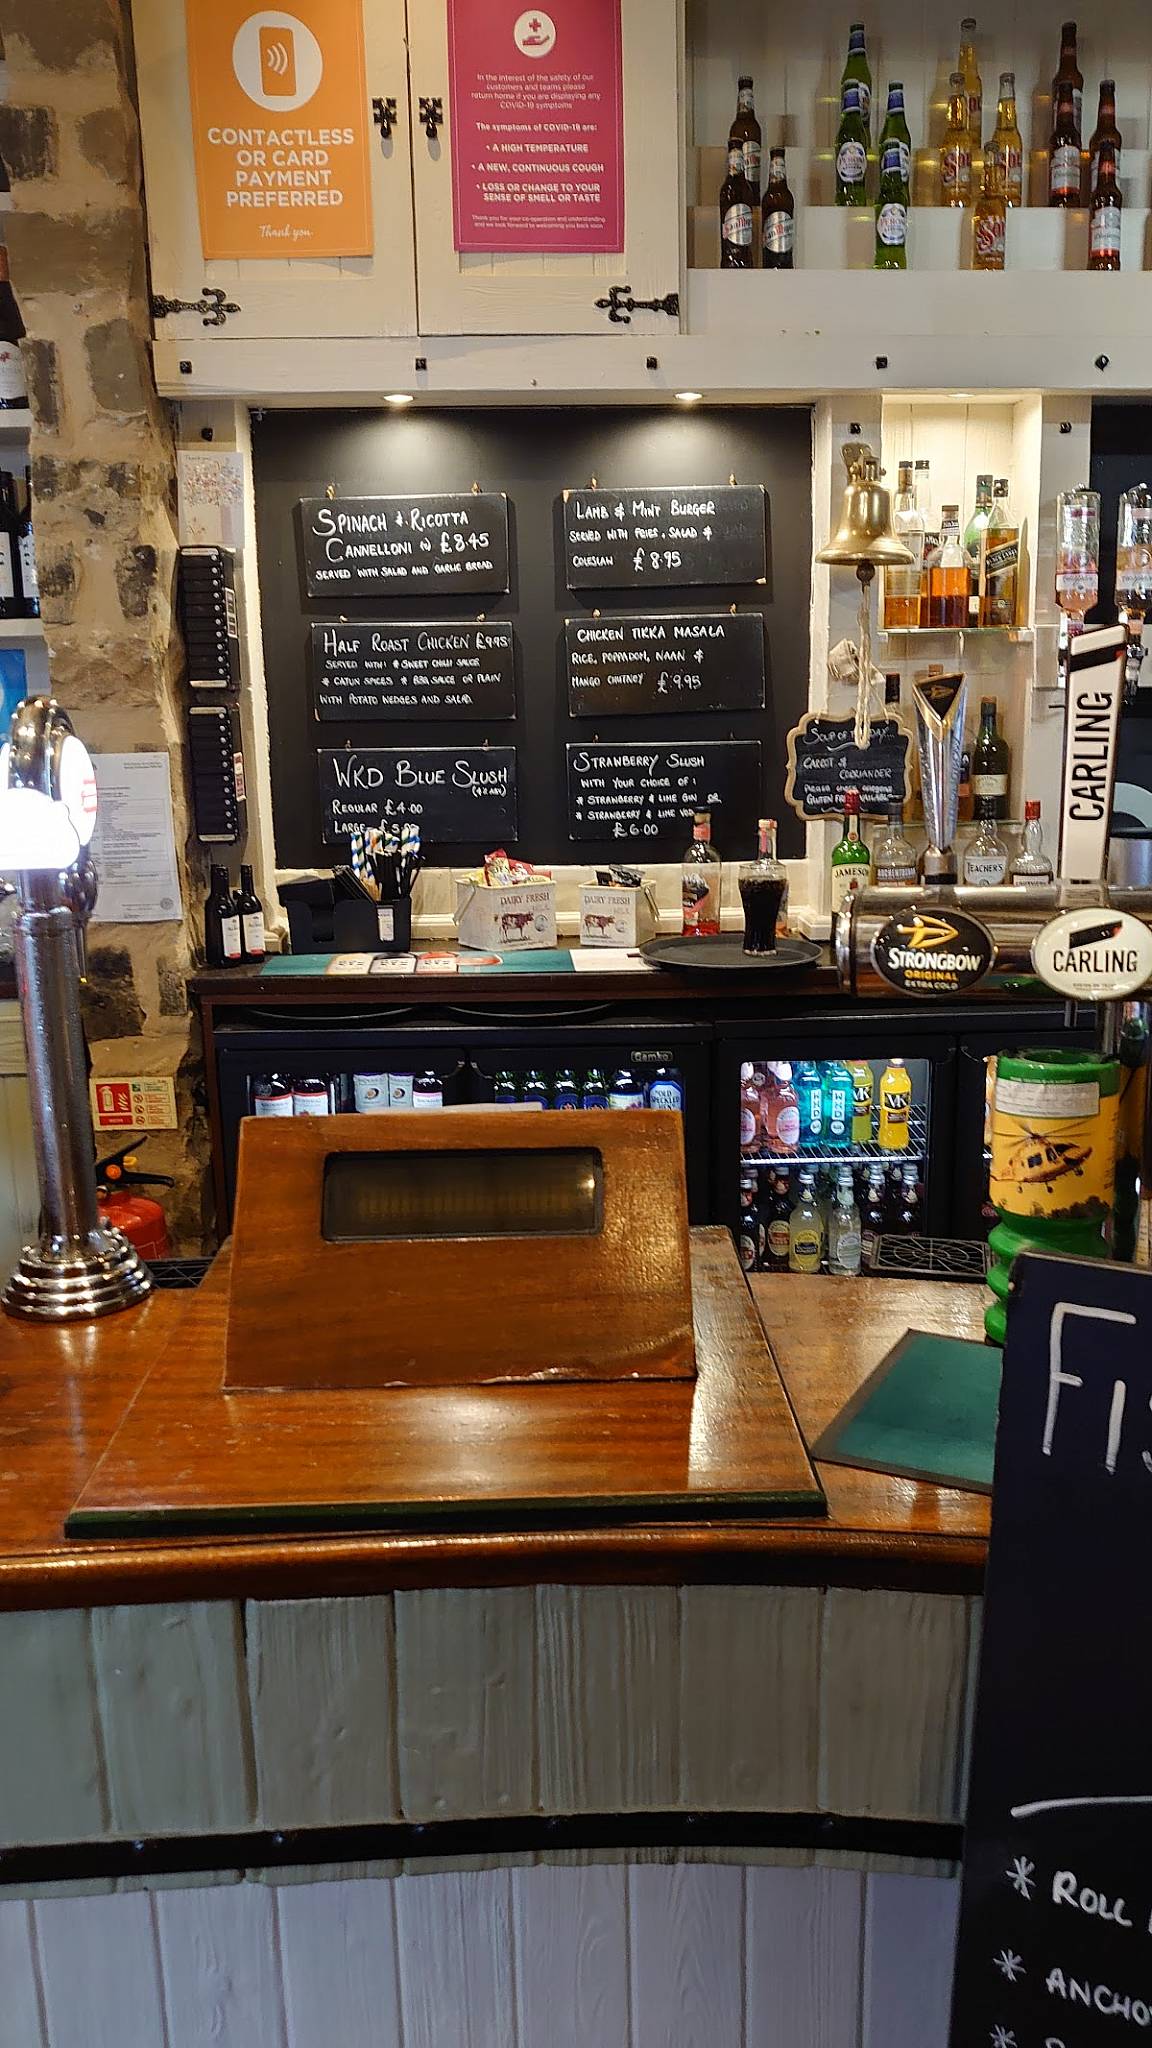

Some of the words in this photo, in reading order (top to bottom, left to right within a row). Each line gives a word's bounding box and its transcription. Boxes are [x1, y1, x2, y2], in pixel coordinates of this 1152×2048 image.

[492, 124, 531, 132] symptoms
[534, 123, 542, 131] of
[208, 128, 354, 145] CONTACTLESS
[492, 144, 499, 152] A
[502, 144, 523, 153] HIGH
[525, 144, 589, 153] TEMPERATURE
[237, 150, 266, 166] OR
[272, 150, 328, 166] CARD
[512, 164, 570, 173] CONTINUOUS
[572, 164, 604, 173] COUGH
[236, 170, 331, 186] PAYMENT
[482, 184, 505, 192] LOSS
[507, 184, 520, 192] OR
[522, 184, 559, 193] CHANGE
[561, 184, 574, 192] TO
[575, 184, 601, 193] YOUR
[227, 191, 343, 208] PREFERRED
[484, 193, 511, 202] SENSE
[513, 193, 525, 202] OF
[528, 193, 556, 202] SMELL
[559, 193, 571, 202] OR
[573, 194, 601, 202] TASTE
[259, 224, 291, 238] Thank
[576, 500, 609, 520] LAMB
[632, 499, 661, 518] MINT
[670, 499, 715, 516] BURGER
[312, 508, 388, 536] SPINACH
[410, 507, 469, 532] RICOTTA
[569, 530, 601, 543] SERVED
[607, 528, 628, 541] WITH
[668, 526, 697, 540] SALAD
[326, 538, 413, 563] CANNELLONI
[440, 532, 490, 554] £8.45
[572, 555, 614, 568] COLESLAW
[316, 569, 351, 581] SERVED
[357, 567, 378, 578] WITH
[381, 566, 408, 577] SALAD
[411, 566, 429, 576] AND
[434, 563, 461, 575] GARLIC
[465, 560, 494, 571] BREAD
[577, 627, 624, 643] CHICKEN
[632, 625, 666, 640] TIKKA
[674, 624, 725, 640] MASALA
[323, 628, 361, 657] HALF
[371, 632, 409, 652] ROAST
[417, 631, 470, 652] CHICKEN
[656, 650, 686, 661] NAAN
[325, 660, 358, 669] SERVED
[400, 660, 429, 669] SWEET
[363, 676, 394, 687] SPICES
[571, 676, 601, 688] MANGO
[319, 694, 343, 705] WITH
[349, 693, 379, 705] POTATO
[382, 695, 418, 705] WEDGES
[421, 694, 441, 705] AND
[573, 752, 659, 776] STRAWBERRY
[666, 754, 705, 768] SLUSH
[1068, 691, 1113, 821] CARLING
[332, 754, 384, 790] WKD
[395, 759, 446, 788] BLUE
[452, 760, 508, 788] SLUSH
[580, 778, 605, 789] WITH
[613, 777, 635, 790] YOUR
[640, 778, 671, 788] CHOICE
[332, 799, 378, 815] REGULAR
[384, 798, 424, 816] £4.00
[587, 794, 645, 807] STRAWBERRY
[658, 794, 677, 803] LIME
[682, 793, 698, 803] GIN
[587, 810, 641, 821] STRAWBERRY
[657, 809, 676, 819] LIME
[334, 821, 367, 834] LARGE
[613, 822, 659, 838] £6.00
[500, 895, 523, 905] DAIRY
[526, 892, 550, 903] FRESH
[584, 895, 605, 905] DAIRY
[608, 896, 631, 905] FRESH
[887, 947, 984, 972] STRONGBOW
[1053, 949, 1139, 973] CARLING
[904, 969, 959, 982] ORIGINAL
[934, 980, 959, 990] COLD
[884, 1093, 909, 1109] VK
[1052, 1871, 1133, 1927] ROLL
[1045, 1967, 1152, 2027] ANCHO
